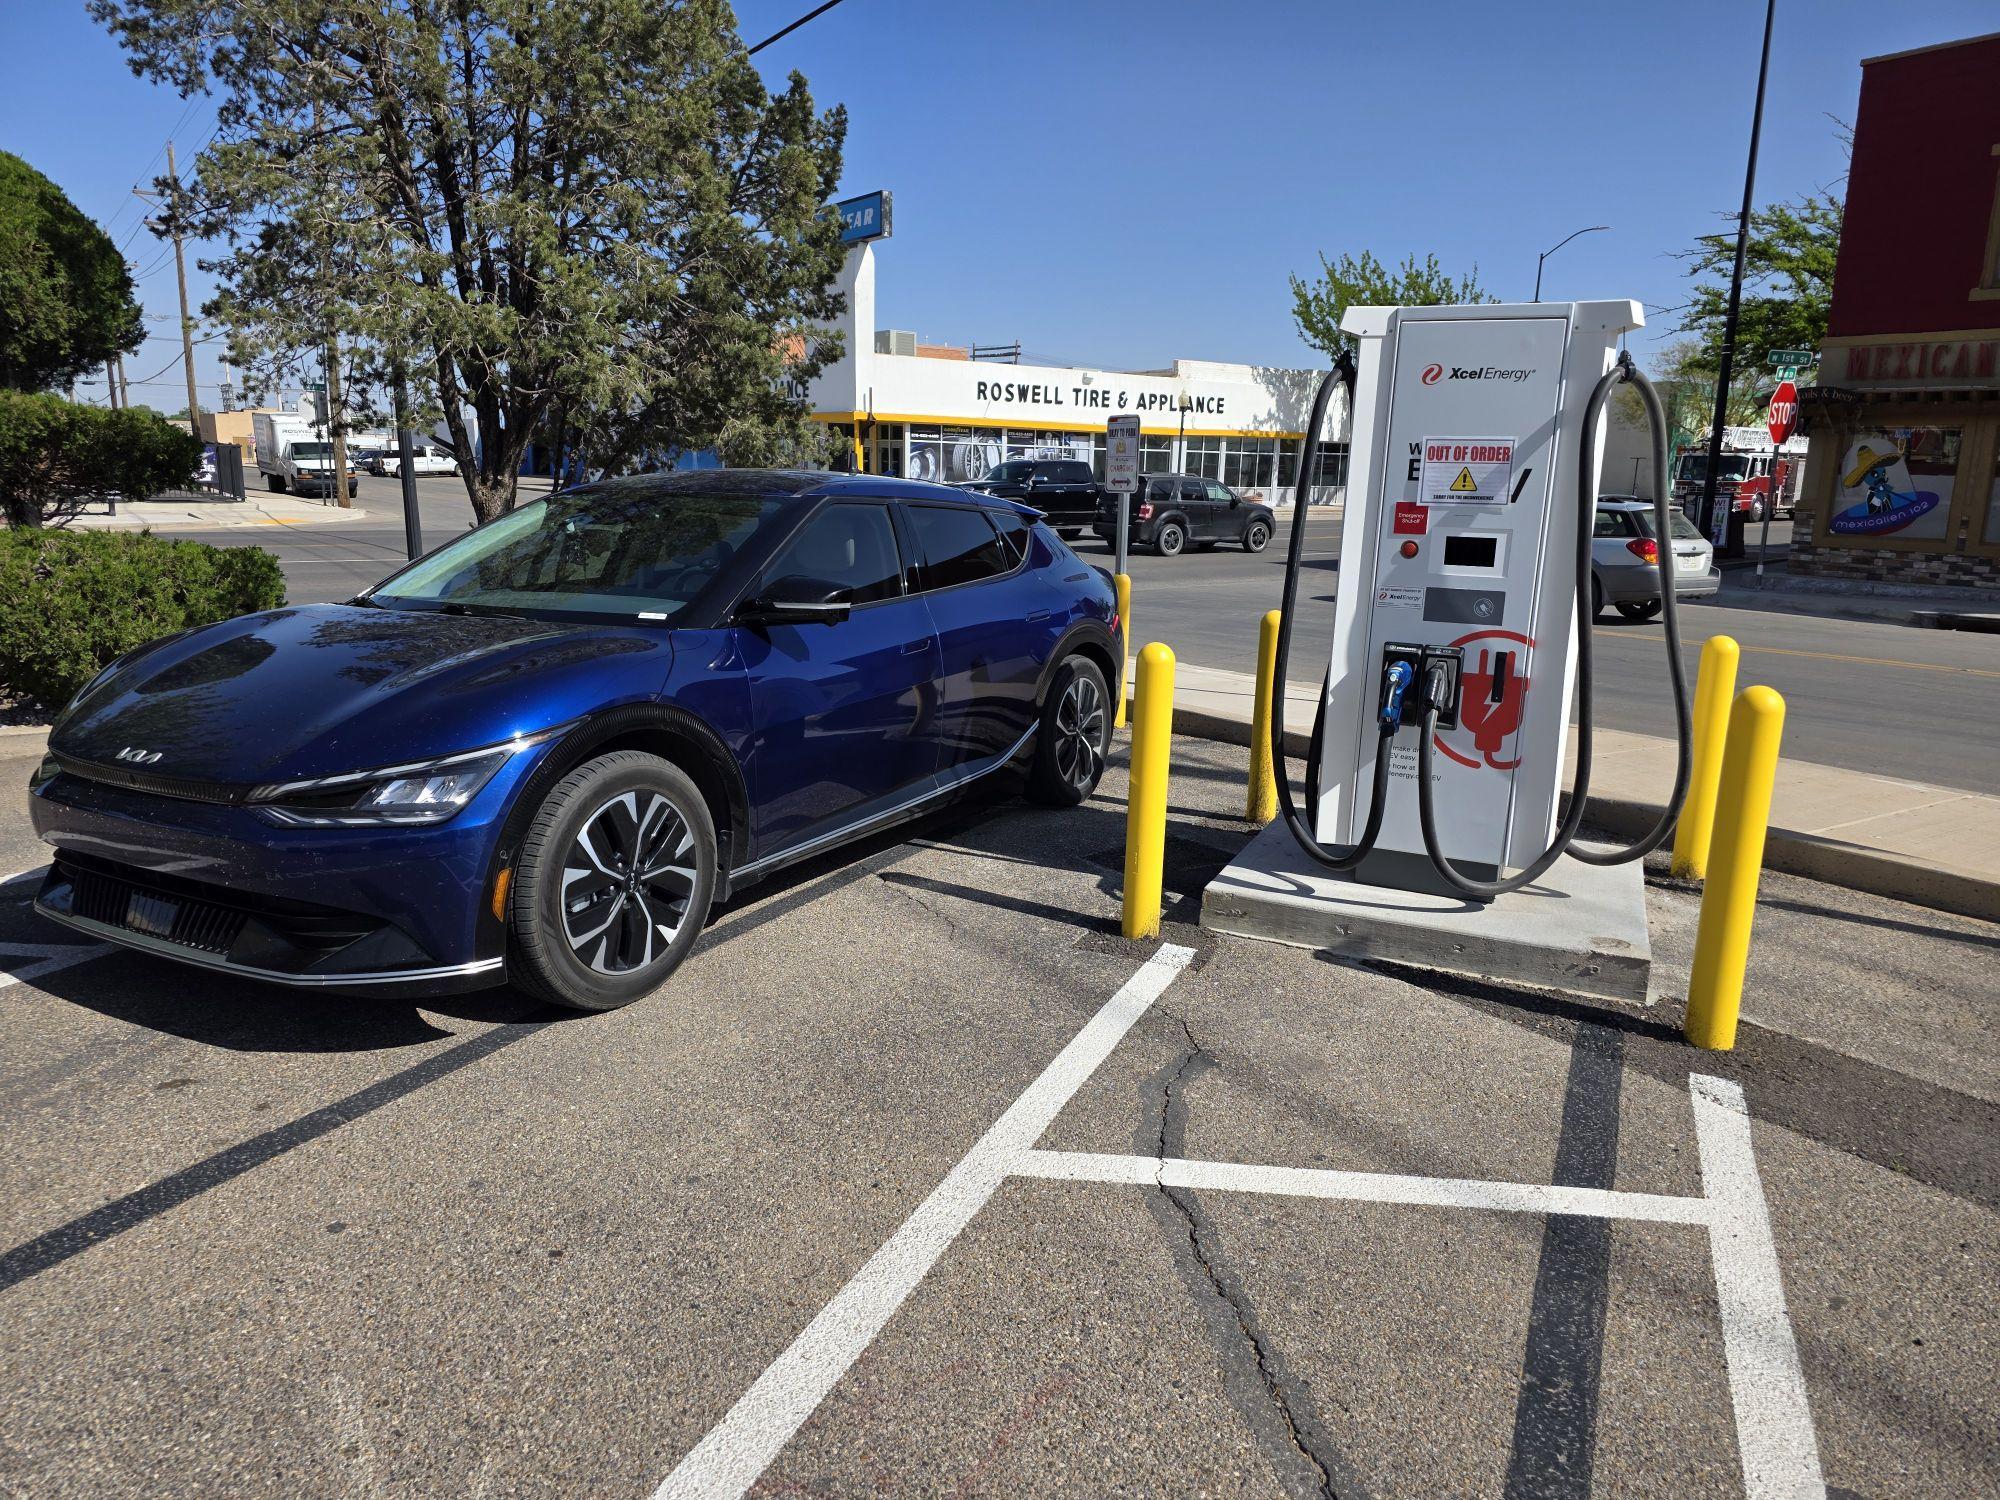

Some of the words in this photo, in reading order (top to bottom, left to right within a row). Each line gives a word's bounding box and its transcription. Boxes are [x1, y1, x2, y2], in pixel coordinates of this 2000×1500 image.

[1782, 354, 1794, 362] 1st
[1846, 342, 1999, 380] MEXICAN
[977, 381, 1064, 405] ROSWELL
[1072, 387, 1110, 408] TIRE
[1117, 391, 1128, 409] &
[1136, 392, 1225, 414] APPLANCE
[1770, 402, 1796, 425] STOP
[1126, 428, 1136, 437] PARK
[1427, 445, 1451, 461] OUT
[1453, 446, 1469, 461] OF
[1470, 446, 1511, 462] ORDER
[1835, 511, 1907, 528] mexicalien
[1910, 501, 1929, 514] 102
[116, 746, 163, 764] KIA
